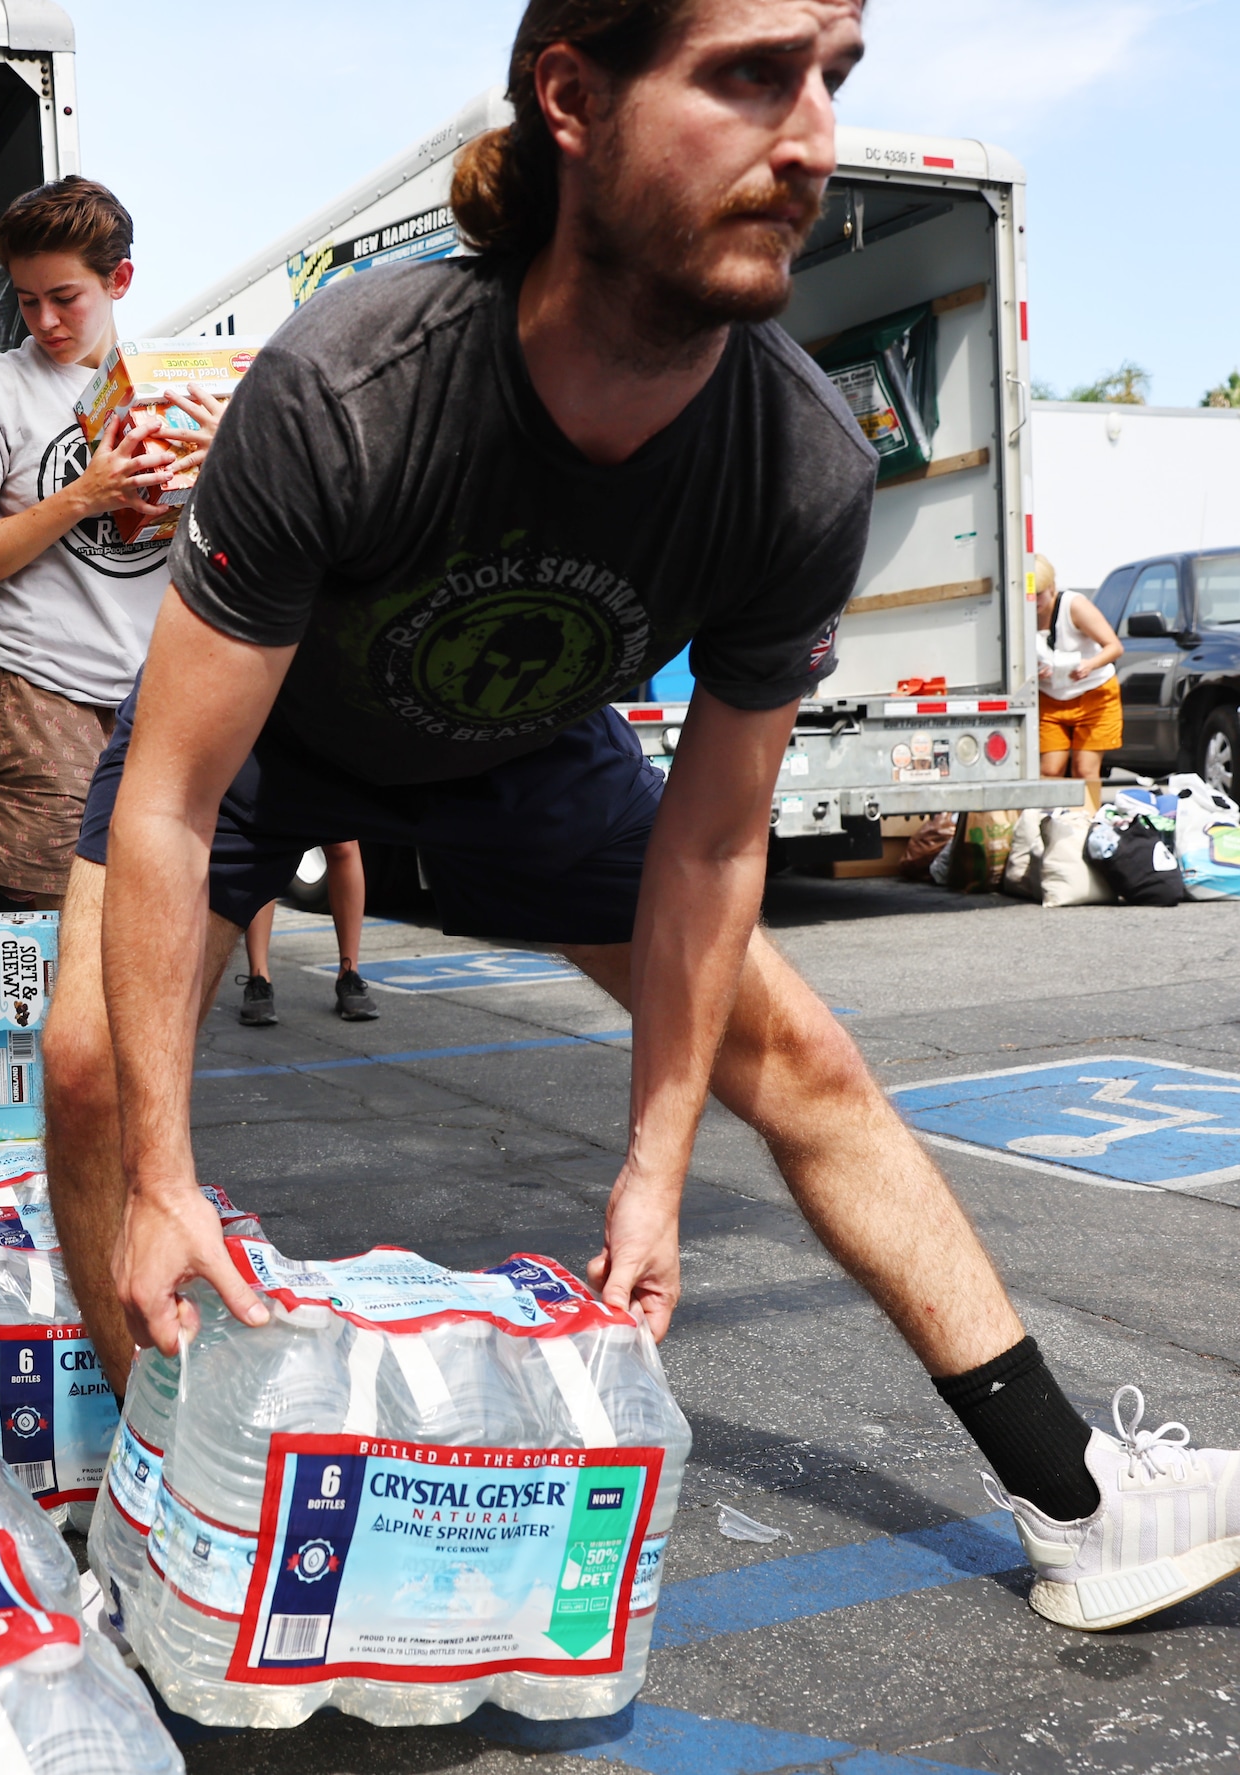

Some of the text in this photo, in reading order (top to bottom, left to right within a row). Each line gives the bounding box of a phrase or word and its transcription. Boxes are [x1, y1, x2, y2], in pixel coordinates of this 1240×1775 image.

[866, 148, 916, 164] DC 4339 F
[354, 234, 379, 258] NEW
[382, 207, 454, 247] HAMPSHIRE
[153, 367, 229, 379] Diced Peaches
[386, 556, 651, 678] Reebok SPARTAN RACE
[389, 697, 557, 741] 2016 BEAST
[2, 941, 20, 999] CHEWY
[21, 946, 38, 1000] SOFT &
[19, 1348, 33, 1374] 6
[11, 1375, 41, 1383] BOTTLES
[360, 1442, 586, 1467] BOTTLED AT THE SOURCE
[321, 1465, 341, 1498] 6
[370, 1473, 565, 1508] CRYSTAL GEYSER
[308, 1498, 345, 1510] BOTTLES
[592, 1493, 620, 1505] NOW!
[371, 1513, 549, 1540] ALPINE SPRING WATER
[412, 1508, 520, 1524] NATURAL
[586, 1548, 619, 1565] 50%
[580, 1572, 612, 1587] PET
